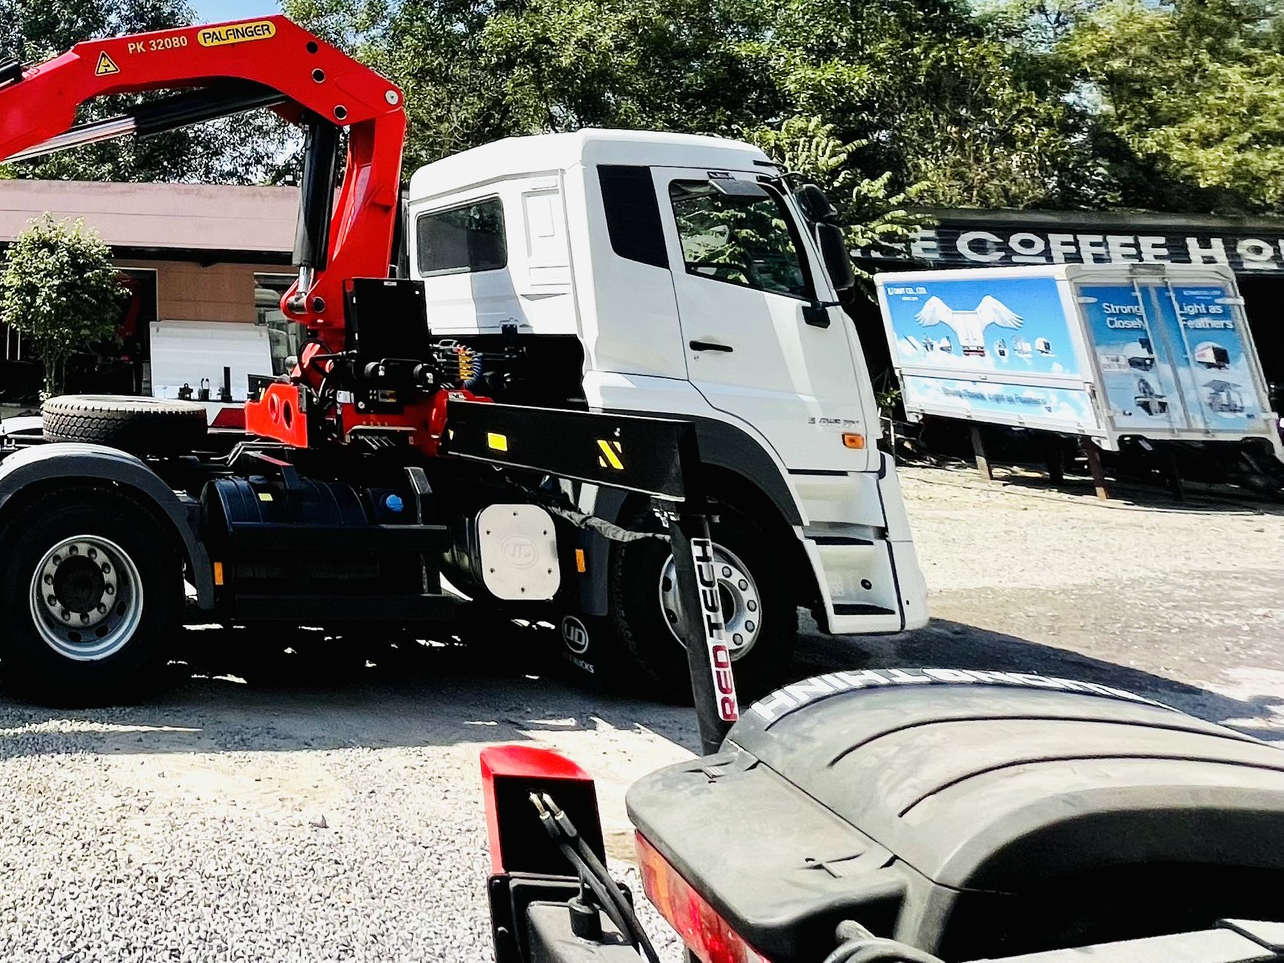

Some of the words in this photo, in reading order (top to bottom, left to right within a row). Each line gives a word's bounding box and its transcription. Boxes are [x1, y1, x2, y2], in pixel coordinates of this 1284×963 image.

[202, 24, 272, 44] PALFINGER
[127, 41, 147, 54] PK
[150, 36, 188, 52] 32080
[956, 231, 1172, 264] COFFEE
[1185, 237, 1284, 269] HO
[1102, 303, 1143, 316] Strong
[1177, 303, 1207, 315] Light
[1208, 305, 1224, 314] as
[1180, 318, 1234, 329] Feathers
[564, 623, 586, 646] UD
